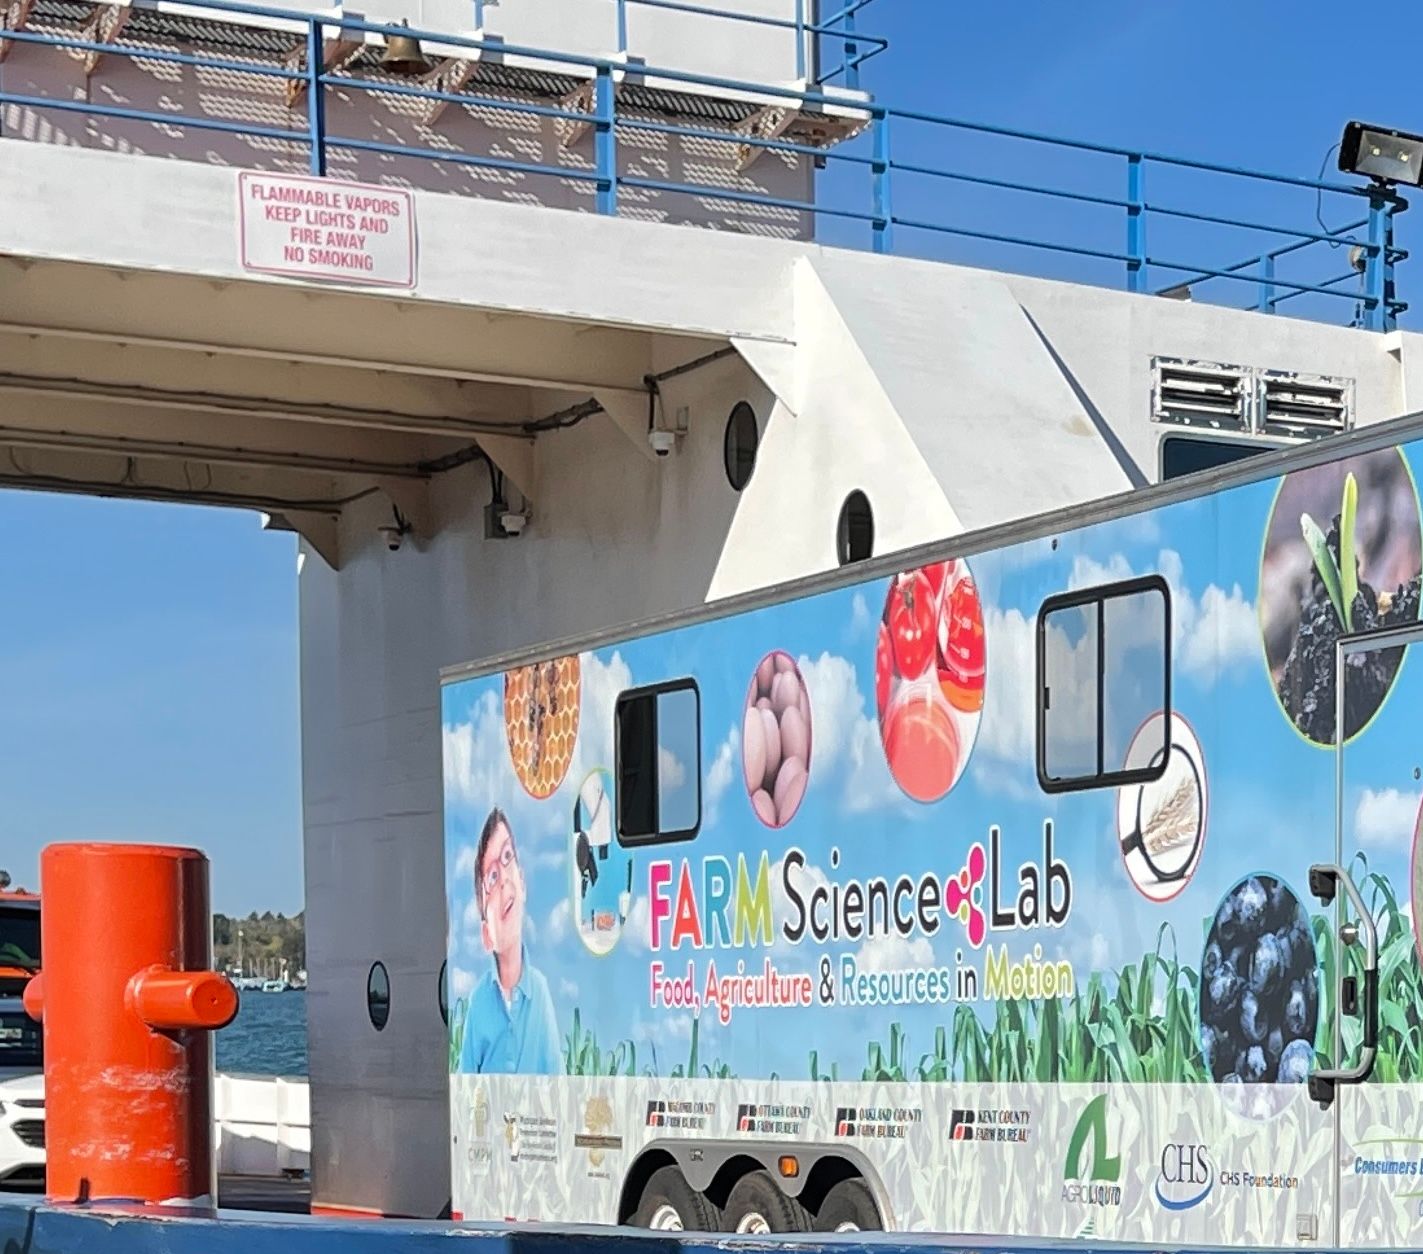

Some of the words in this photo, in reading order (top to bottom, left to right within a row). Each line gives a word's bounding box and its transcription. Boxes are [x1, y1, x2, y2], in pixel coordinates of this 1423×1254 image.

[252, 184, 341, 209] FLAMMABLE
[344, 194, 400, 216] VAPORS
[265, 205, 301, 223] KEEP
[306, 211, 356, 230] LIGHTS
[359, 216, 388, 234] AND
[291, 227, 322, 246] FIRE
[326, 232, 366, 250] AWAY
[284, 246, 304, 262] NO
[308, 247, 373, 271] SMOKING
[651, 852, 774, 949] FARM
[782, 849, 941, 942] Science
[990, 822, 1072, 928] Lab
[652, 961, 700, 1013] Food,
[704, 958, 812, 1023] Agriculture
[819, 957, 835, 1004] &
[841, 953, 948, 1003] Resources
[957, 952, 977, 1000] in
[985, 945, 1073, 1000] Motion
[859, 1108, 892, 1122] OAKLAND
[894, 1108, 922, 1123] COUNTY
[977, 1109, 998, 1124] KENT
[1000, 1109, 1031, 1124] COUNTY
[857, 1123, 875, 1137] FARM
[975, 1126, 994, 1142] FARM
[996, 1127, 1028, 1142] BUREAU
[1161, 1143, 1209, 1184] CHS
[1355, 1156, 1417, 1175] Consumers
[1220, 1171, 1240, 1186] CHS
[1243, 1172, 1298, 1189] Foundation
